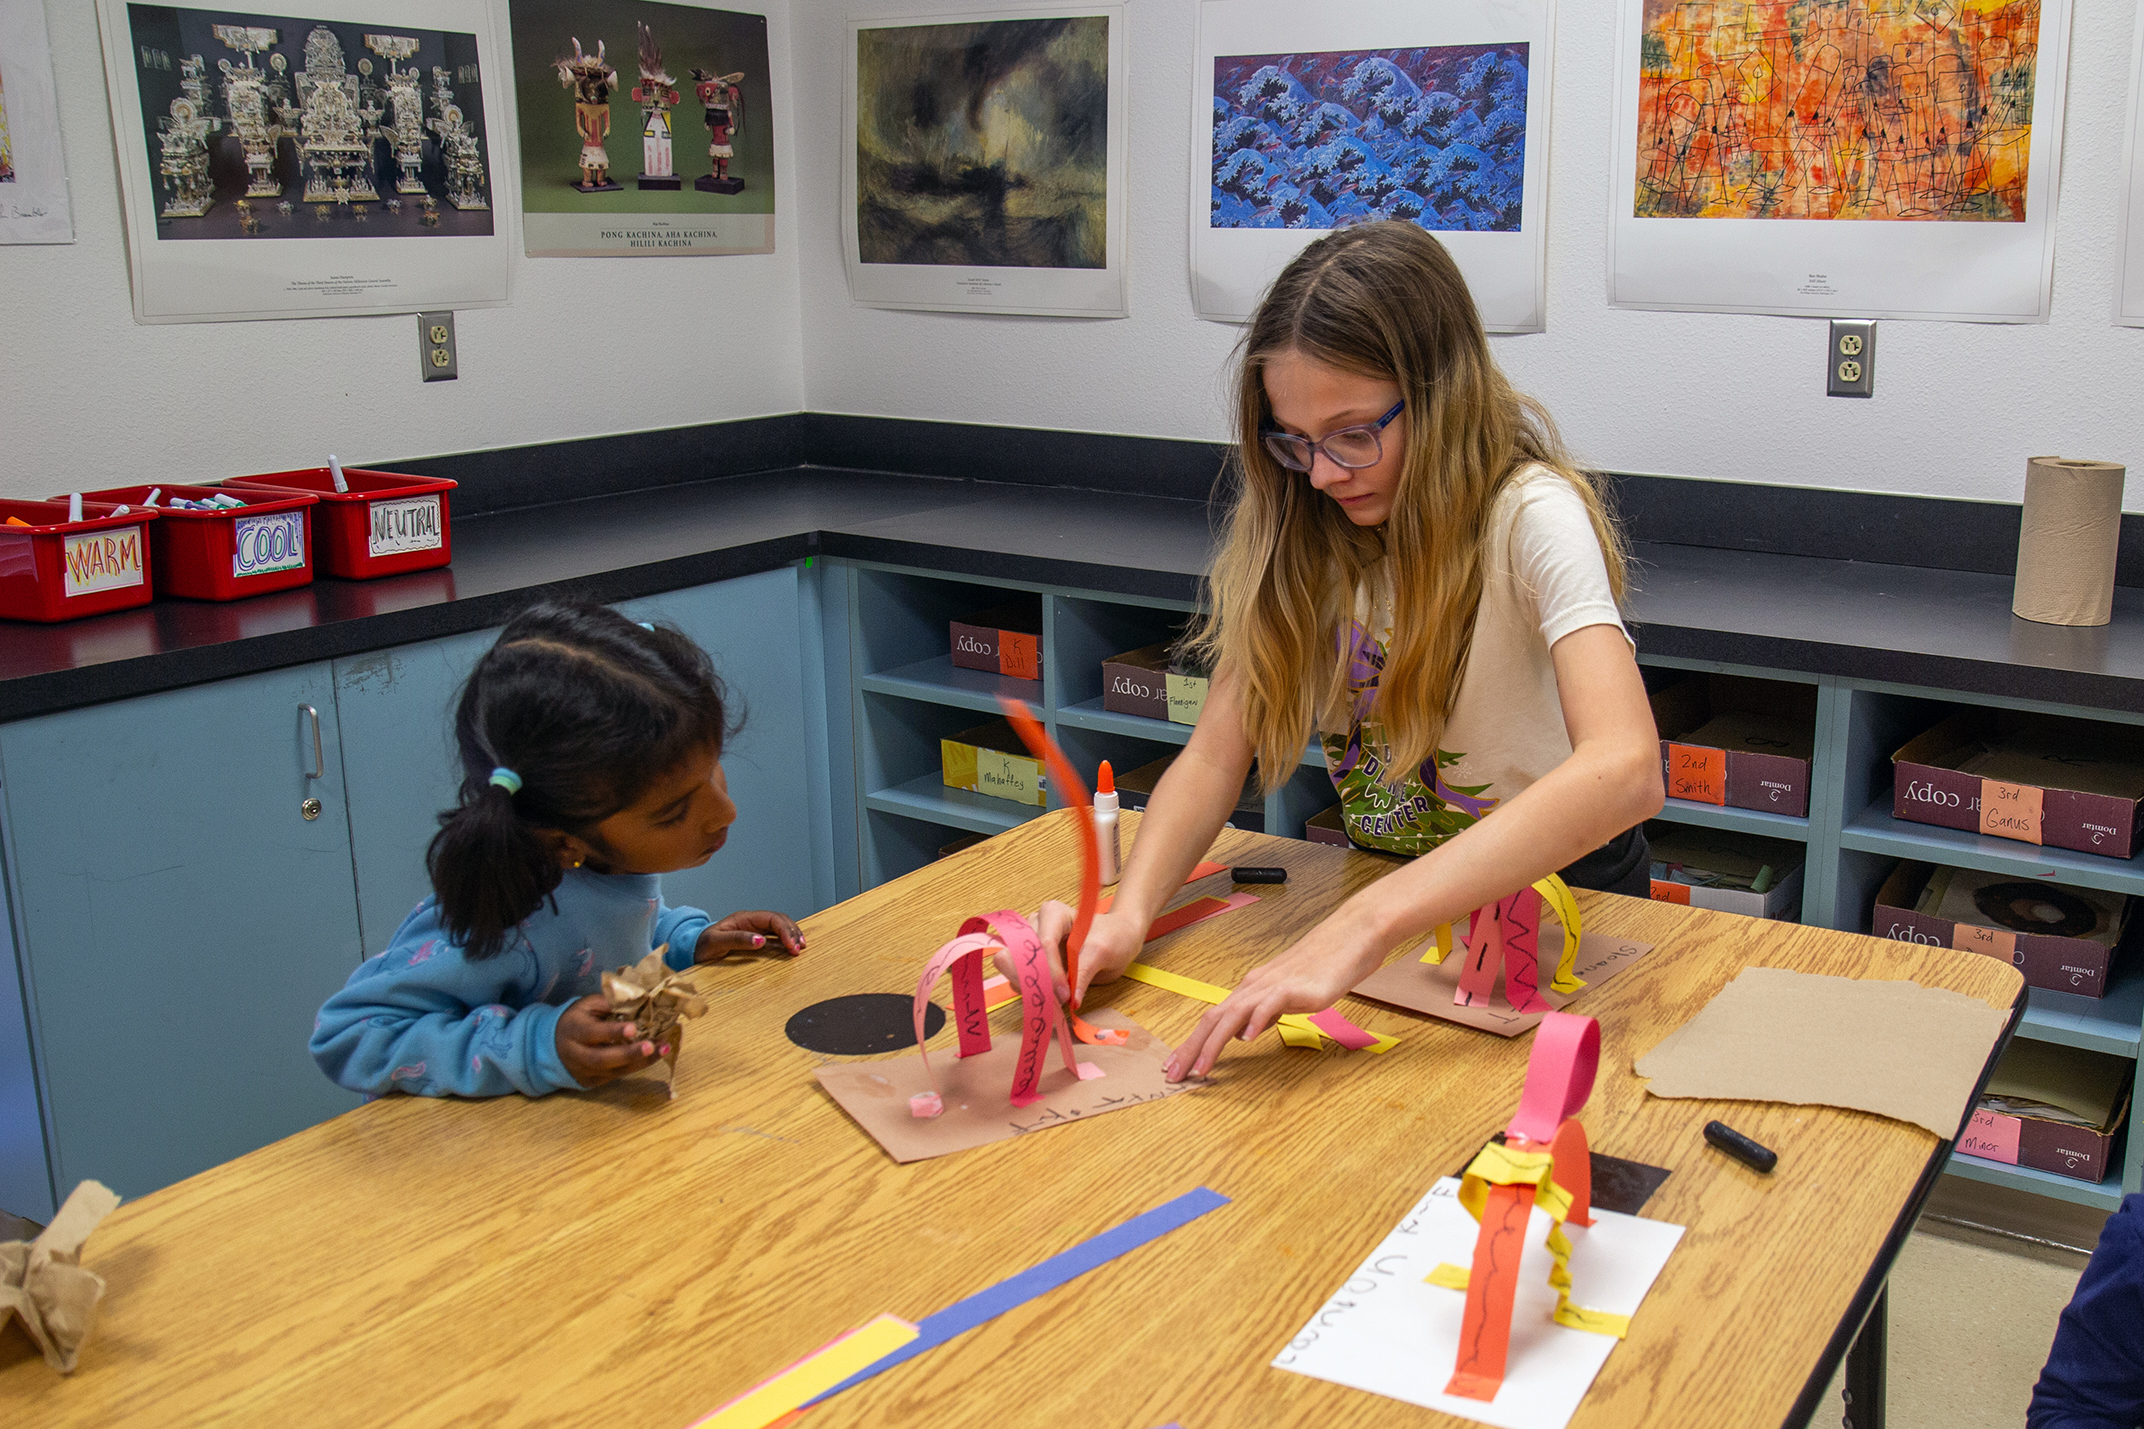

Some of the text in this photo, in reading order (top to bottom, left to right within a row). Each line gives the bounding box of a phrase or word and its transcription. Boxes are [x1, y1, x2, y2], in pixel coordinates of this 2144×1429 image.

[600, 230, 624, 239] PONG
[666, 230, 680, 238] AHA
[630, 240, 692, 248] HILILI KACHINA
[372, 505, 440, 545] NEUTRAL
[237, 522, 299, 571] COOL
[65, 534, 142, 585] WARM
[956, 635, 991, 656] copy
[1111, 676, 1150, 698] copy
[1183, 678, 1197, 689] 1st
[1003, 758, 1010, 774] K
[1682, 754, 1708, 771] 2nd
[1675, 778, 1712, 795] Smith
[1760, 780, 1792, 792] Domtar
[1903, 780, 1960, 808] copy
[1997, 786, 2020, 802] 3rd
[1360, 796, 1431, 836] CENTER
[1986, 808, 2030, 832] Ganus
[2082, 822, 2117, 836] Domtar
[1973, 928, 1994, 944] 3rd
[2060, 964, 2095, 977] Domtar
[1972, 1110, 1994, 1128] 3rd
[1964, 1136, 2000, 1152] Minor
[2056, 1148, 2090, 1162] Domtar
